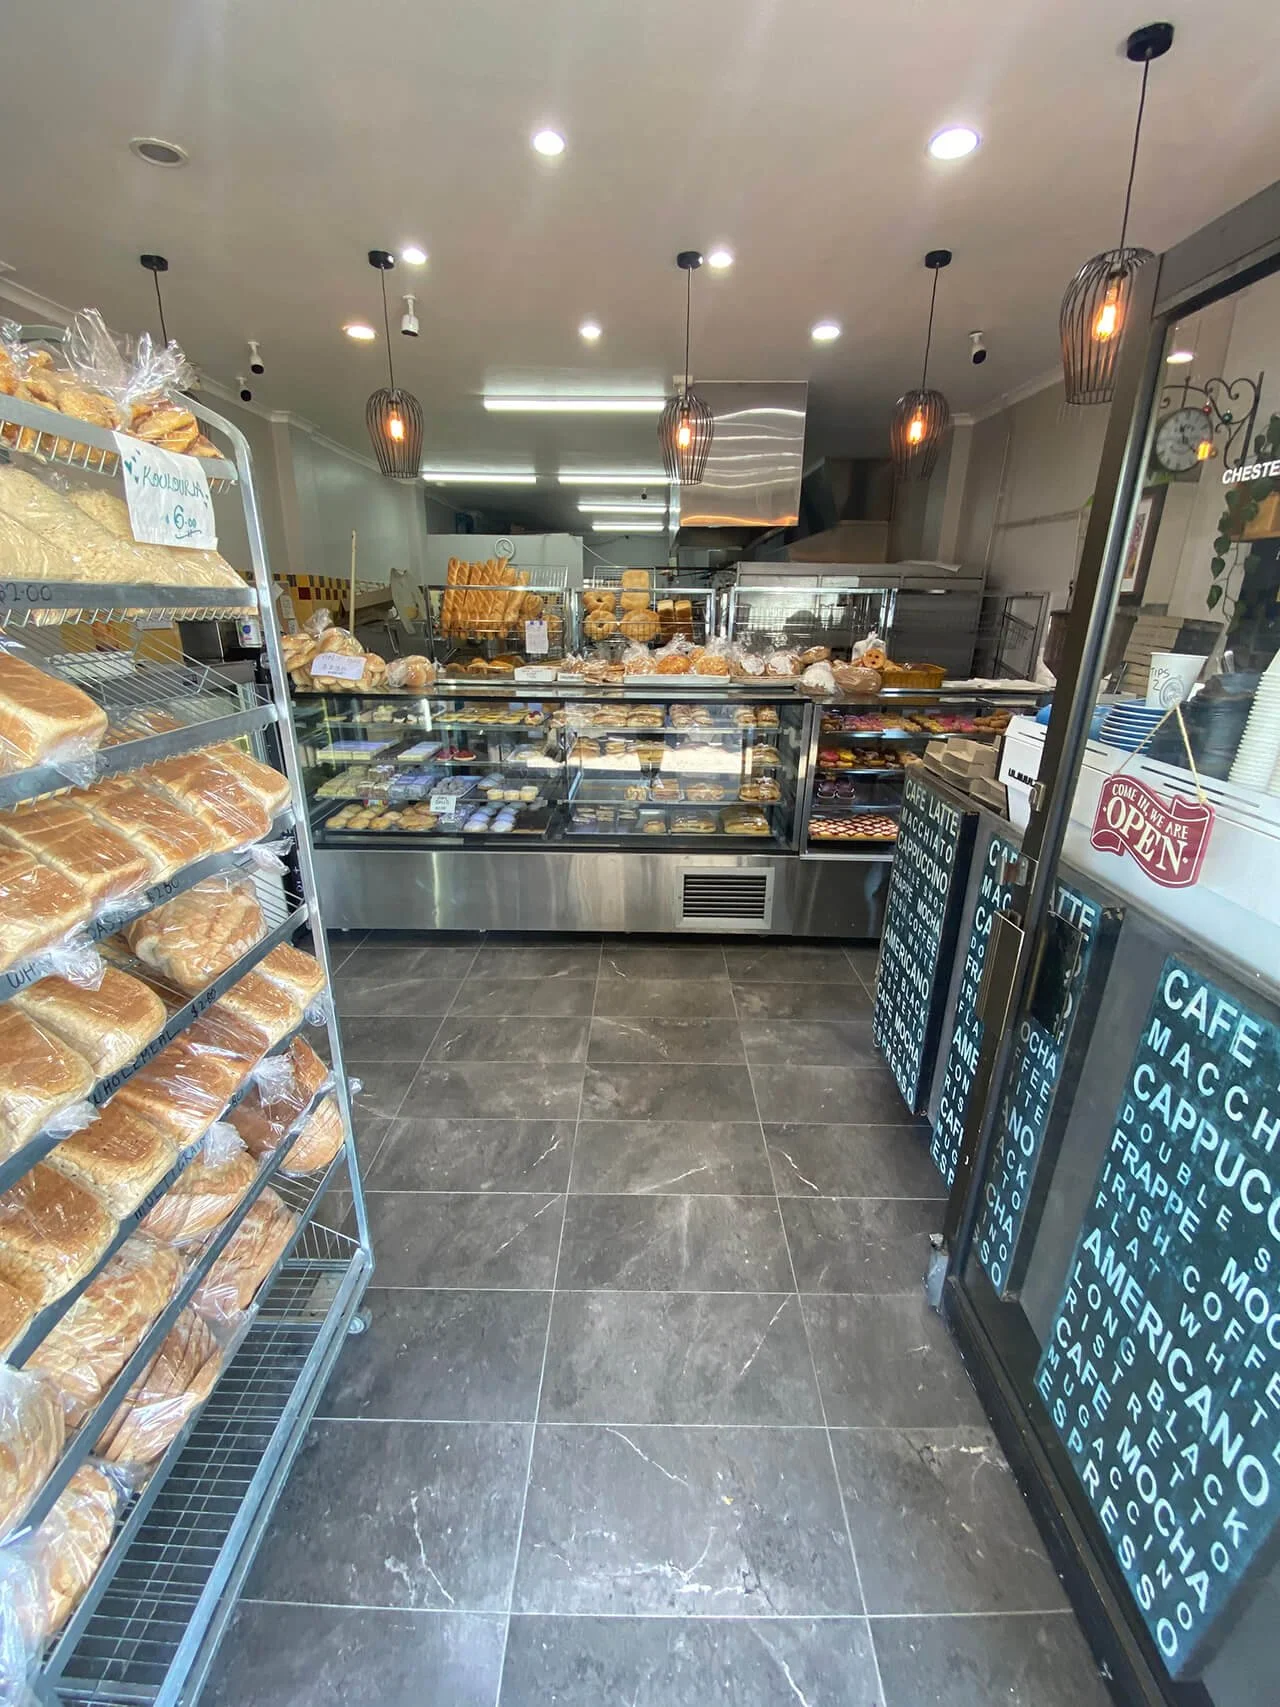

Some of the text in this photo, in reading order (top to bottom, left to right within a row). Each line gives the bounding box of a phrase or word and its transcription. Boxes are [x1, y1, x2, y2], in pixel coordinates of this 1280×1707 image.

[902, 806, 953, 864] MACCHIATO
[905, 779, 959, 836] CAFE LATTE
[1106, 796, 1188, 876] OPEN
[1112, 783, 1138, 801] COME
[1150, 808, 1165, 828] WE
[1164, 822, 1189, 840] ARE
[891, 869, 941, 935] FRAPPE MOCHA
[897, 830, 948, 895] CAPPUCCINO
[923, 884, 945, 914] SHOT
[884, 924, 929, 1001] AMERICANO
[907, 912, 937, 957] COFFEE
[907, 931, 934, 975] WHITE
[877, 982, 919, 1068] CAFE MOCHA
[880, 963, 923, 1042] RISTRETTO
[881, 949, 926, 1025] LONG BLACK
[1163, 969, 1262, 1068] CAFE
[1103, 1162, 1171, 1256] IRISH
[1111, 1128, 1200, 1244] FRAPPE
[1122, 1103, 1233, 1232] DOUBLE
[1095, 1191, 1160, 1281] FLAT
[1073, 1261, 1249, 1549] LONG BLACK
[1082, 1227, 1269, 1507] AMERICANO
[1056, 1316, 1210, 1614] CAFE MOCHA
[1065, 1286, 1230, 1573] RISTRETTO
[1038, 1368, 1178, 1657] ESPRESSO
[1048, 1344, 1194, 1631] MUGACCINO
